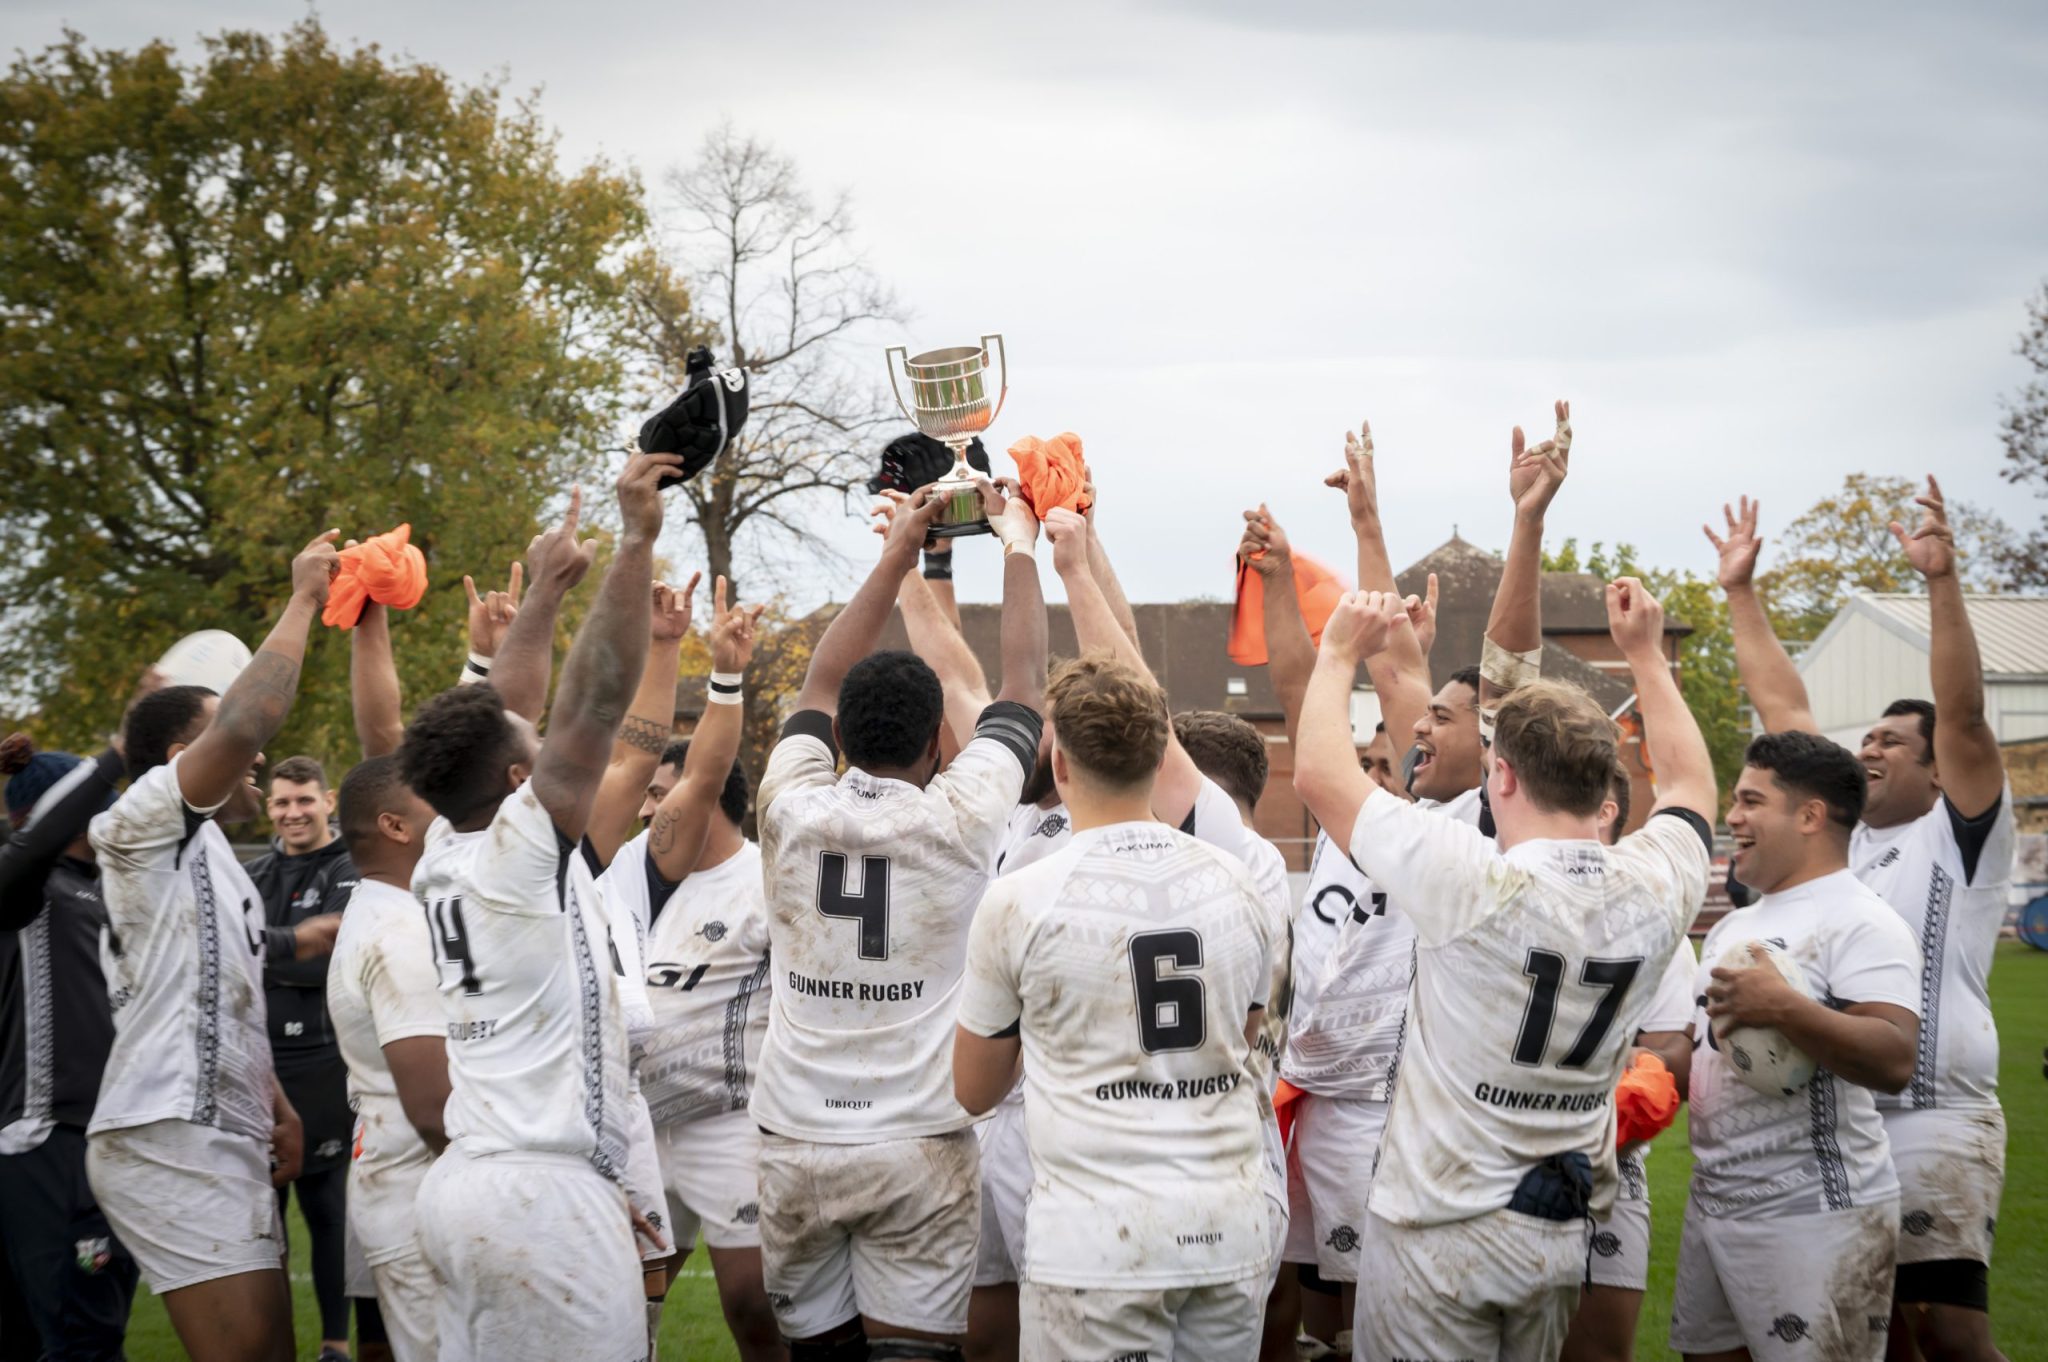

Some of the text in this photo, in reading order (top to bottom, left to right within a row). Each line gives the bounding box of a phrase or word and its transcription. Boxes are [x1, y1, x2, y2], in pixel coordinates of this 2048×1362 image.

[1114, 842, 1176, 853] AKUMA
[816, 850, 890, 961] 4
[789, 971, 925, 1002] GUNNER RUGBY
[1127, 926, 1207, 1058] 6
[1511, 946, 1646, 1070] 17
[1096, 1072, 1241, 1101] GUNNER RUGBY
[1474, 1082, 1557, 1110] GUNNER
[825, 1098, 874, 1111] UBIQUE
[1176, 1231, 1224, 1247] UBIQUE
